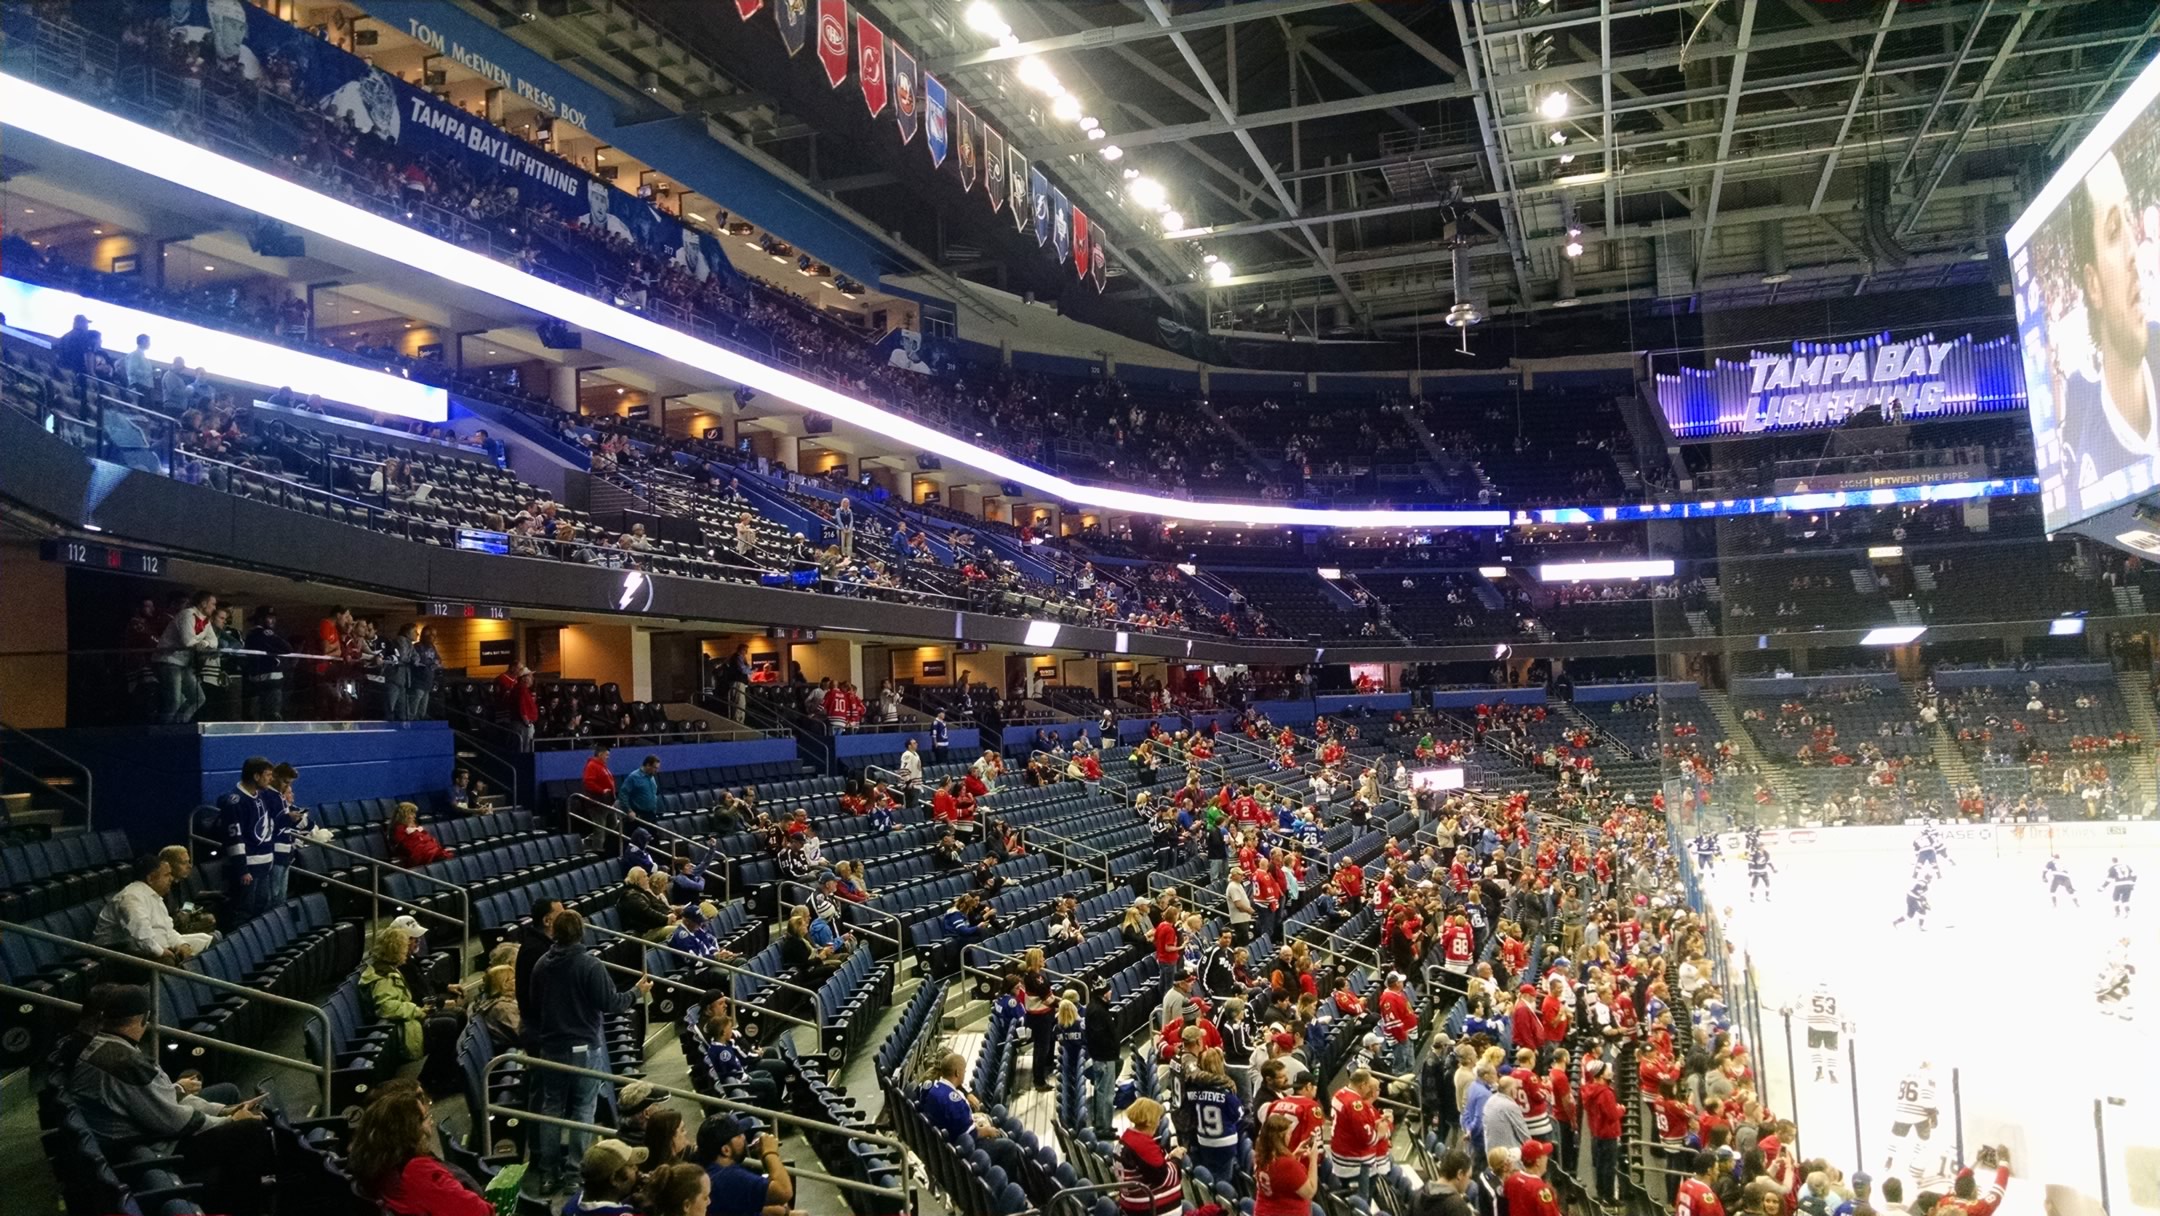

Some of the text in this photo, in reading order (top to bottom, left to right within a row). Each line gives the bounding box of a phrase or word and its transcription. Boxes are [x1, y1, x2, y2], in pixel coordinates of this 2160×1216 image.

[409, 18, 587, 130] TOM McEWEN PRESS BOX
[411, 96, 466, 144] TAMPA
[467, 126, 501, 158] BAY
[1749, 342, 1954, 393] TAMPA BAY
[1874, 474, 1920, 486] BETWEEN
[1921, 473, 1940, 483] THE
[1943, 471, 1970, 480] PIPES
[823, 531, 835, 539] 216
[68, 543, 86, 562] 112
[142, 555, 159, 573] 112
[434, 603, 448, 616] 112
[491, 607, 504, 619] 114
[834, 698, 846, 713] 10
[228, 823, 242, 837] 51
[1303, 832, 1318, 845] 26
[1453, 939, 1468, 955] 88
[1811, 996, 1836, 1015] 53
[1198, 1091, 1226, 1103] ESTEVES
[1195, 1103, 1223, 1136] 19
